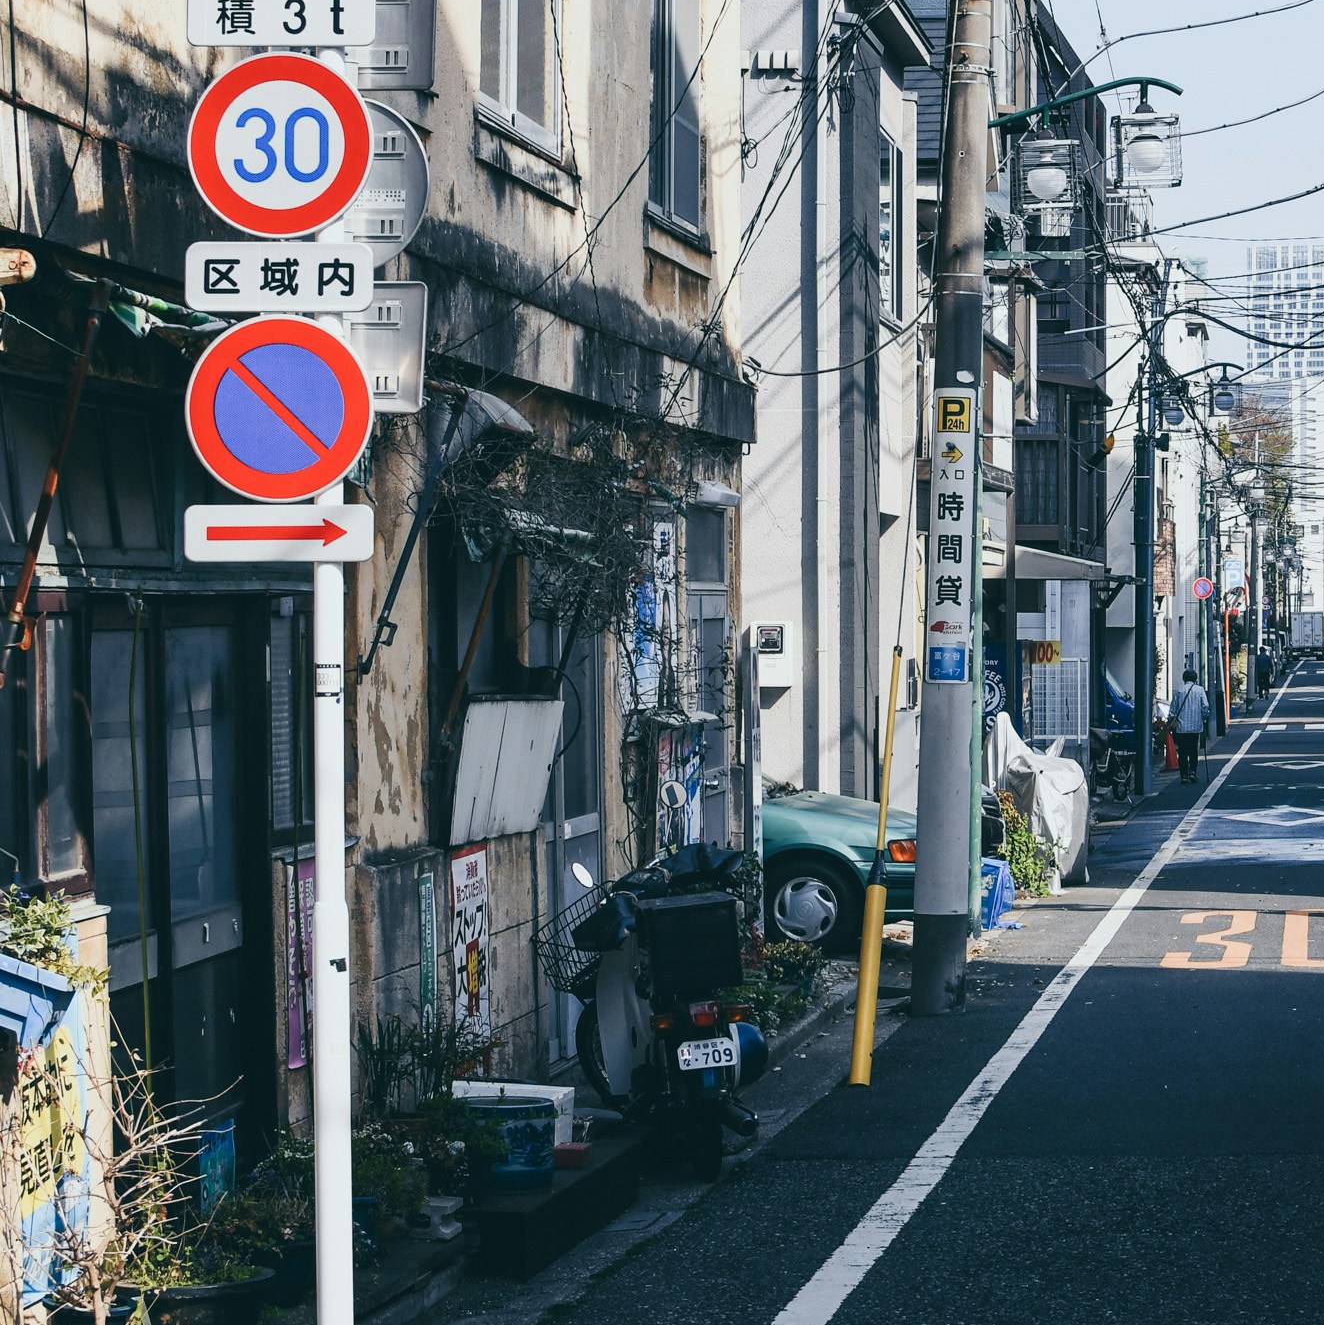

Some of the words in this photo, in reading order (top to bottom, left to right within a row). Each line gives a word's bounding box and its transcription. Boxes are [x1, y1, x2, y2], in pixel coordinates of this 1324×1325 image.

[233, 106, 330, 183] 30
[203, 258, 356, 297] 区域内
[942, 400, 965, 429] P
[948, 418, 965, 430] 24h
[939, 470, 964, 480] 入口
[935, 491, 964, 606] 時間貸
